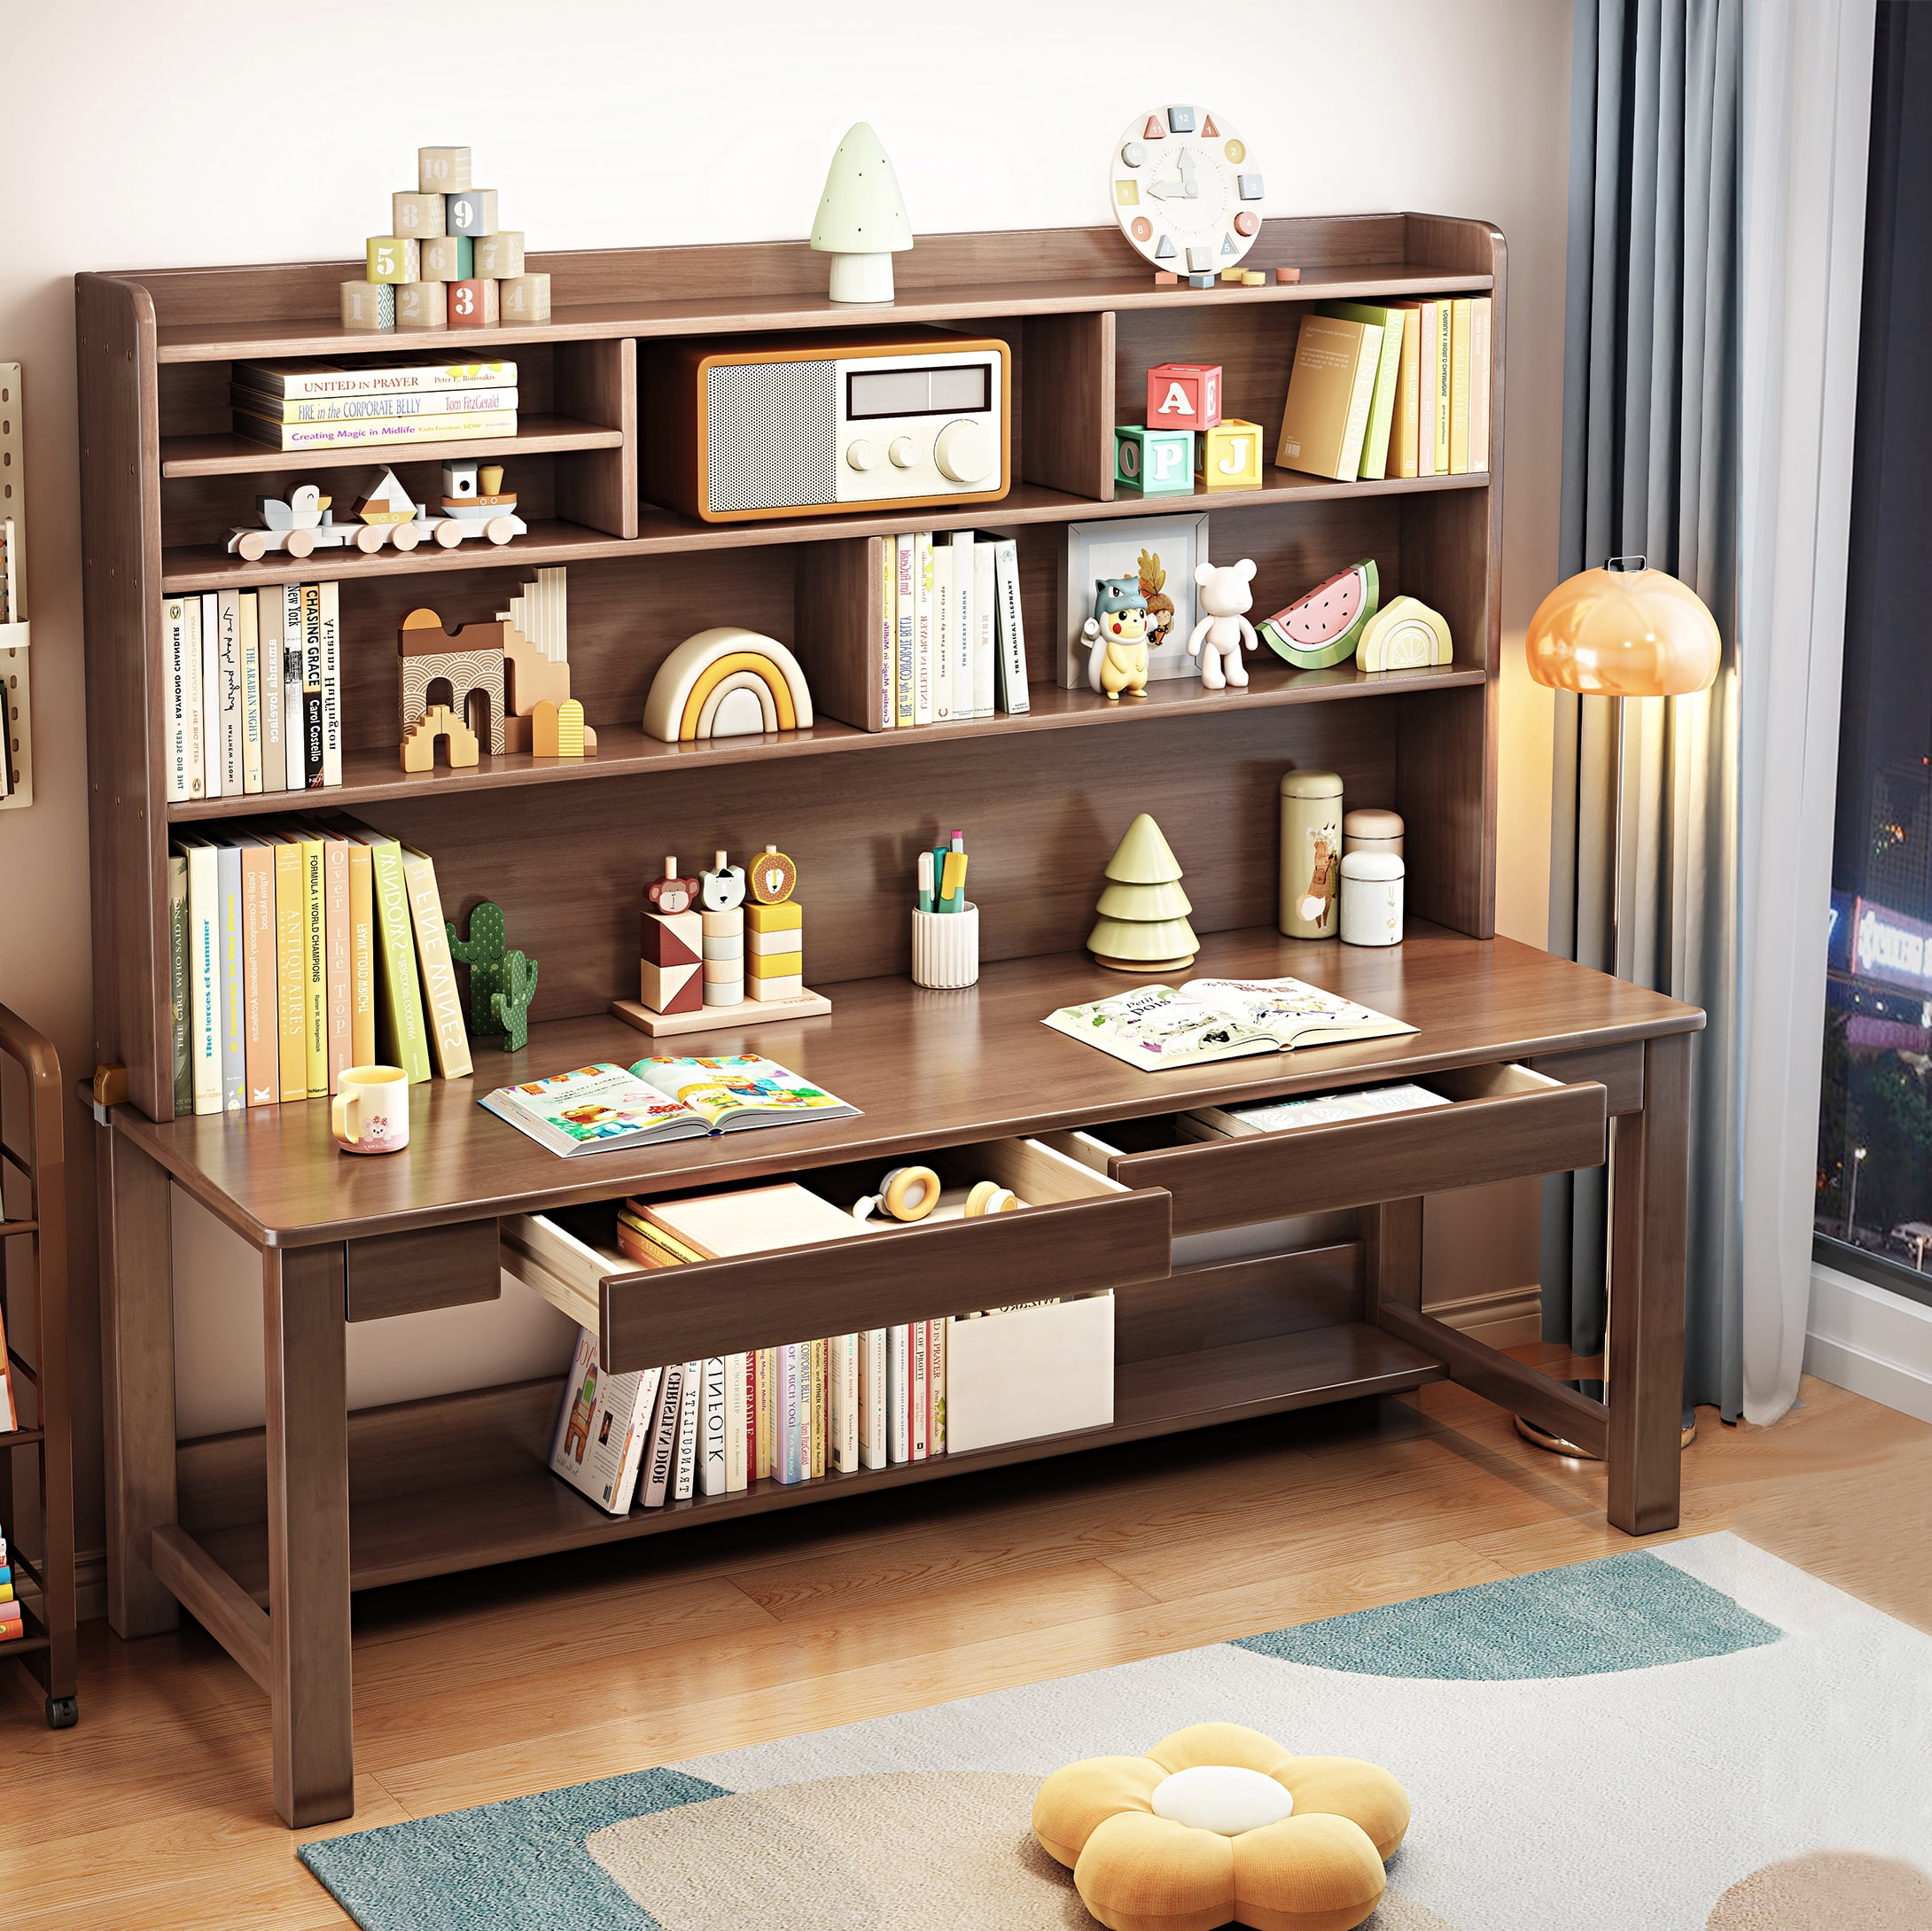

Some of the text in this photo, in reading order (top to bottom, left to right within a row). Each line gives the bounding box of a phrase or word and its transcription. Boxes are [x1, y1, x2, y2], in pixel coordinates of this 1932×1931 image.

[424, 160, 448, 178] 10
[402, 204, 418, 227] 8
[454, 200, 473, 228] 9
[376, 247, 394, 275] 5
[429, 247, 446, 270] 6
[482, 245, 497, 270] 7
[351, 293, 363, 320] 1
[402, 291, 419, 316] 2
[455, 287, 474, 315] 3
[506, 285, 525, 311] 4
[1383, 315, 1402, 384] WINDOWS
[305, 381, 355, 392] UNITED
[373, 377, 418, 388] PRAYER
[299, 393, 499, 420] FIRE in the CORPORATE BELLY Tom FitzGerald
[1157, 382, 1196, 416] A
[1344, 346, 1377, 461] FINE WINES
[338, 430, 366, 439] Magic
[382, 425, 415, 435] Midlife
[1152, 444, 1183, 481] P
[1219, 439, 1250, 475] J
[288, 586, 301, 627] New York
[306, 589, 321, 762] CHASING GRACE Carol Costello
[246, 646, 257, 743] THE ARABIAN NIGHTS
[310, 854, 319, 895] FORMULA
[311, 902, 320, 932] WORLD
[331, 851, 345, 973] Over the
[286, 909, 303, 1035] ANTIQUAIRES
[311, 934, 320, 983] CHAMPIONS
[204, 977, 211, 989] of
[1130, 1000, 1171, 1016] pois
[230, 1042, 238, 1053] A
[918, 1337, 923, 1348] OF
[934, 1333, 939, 1342] IN
[789, 1346, 795, 1359] OF
[801, 1343, 810, 1382] CORPORATE
[801, 1384, 810, 1404] BELLY
[790, 1434, 795, 1444] Ed
